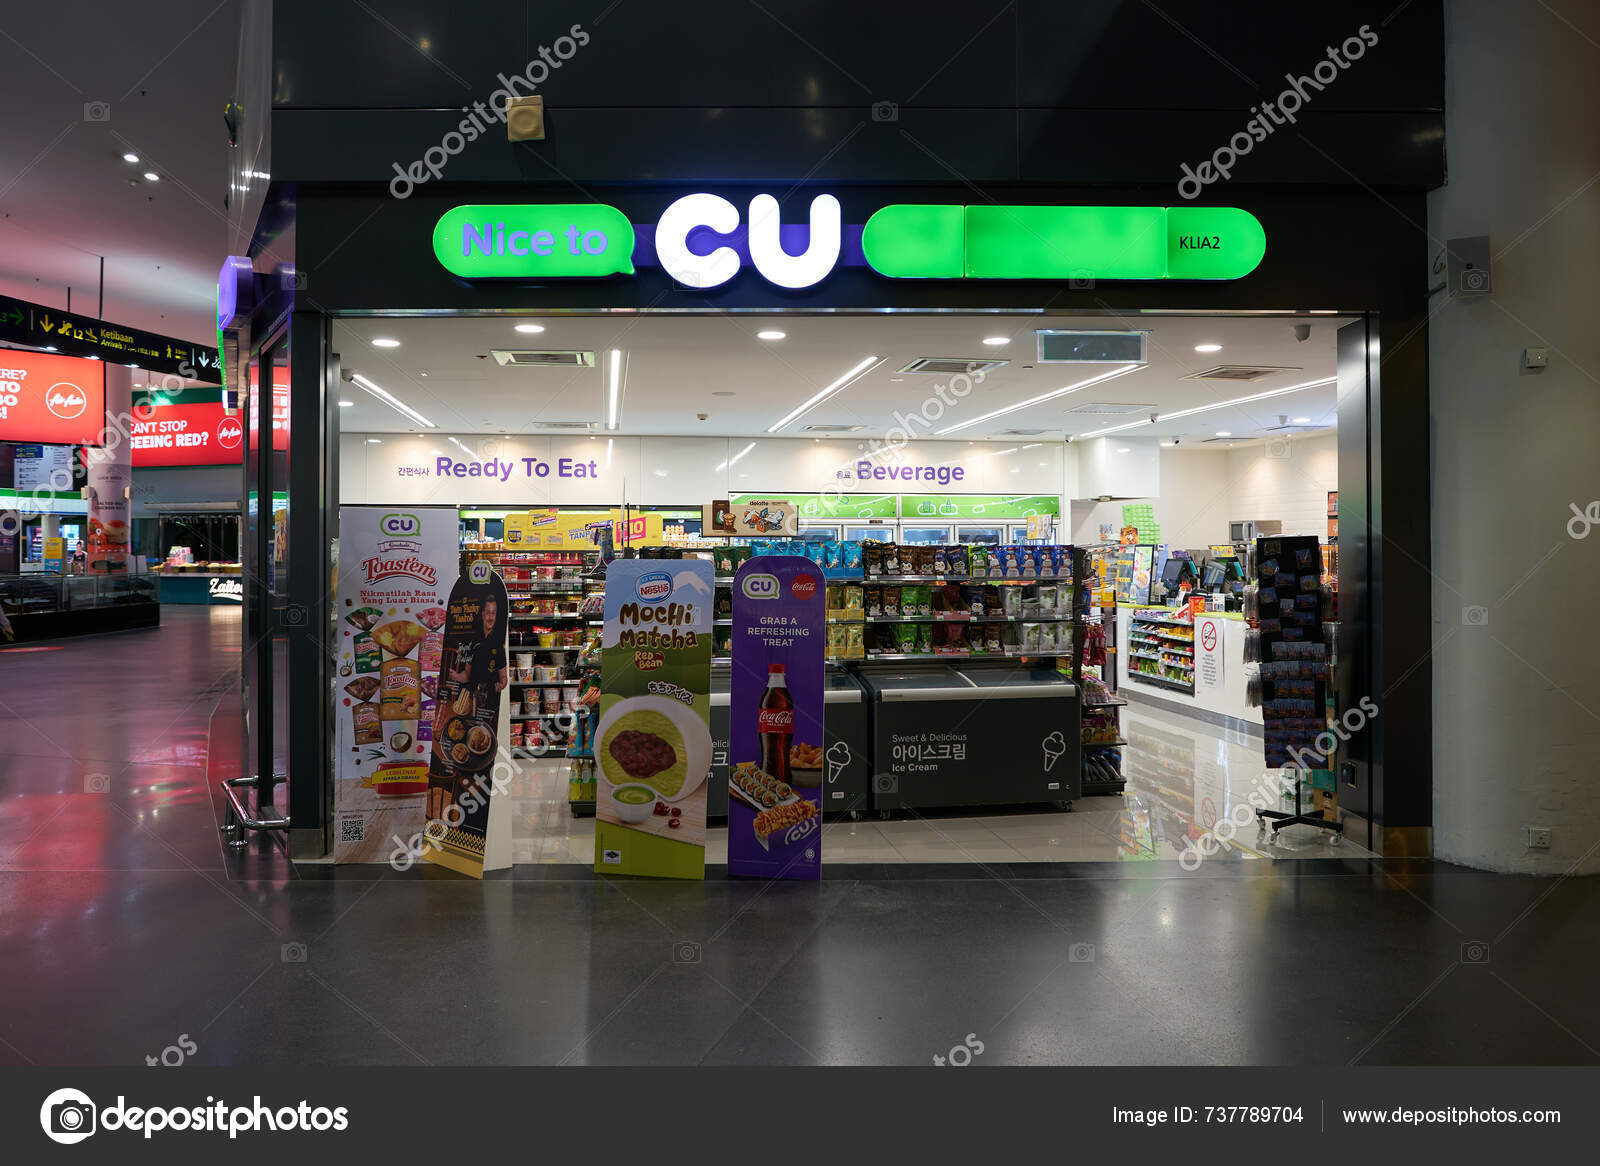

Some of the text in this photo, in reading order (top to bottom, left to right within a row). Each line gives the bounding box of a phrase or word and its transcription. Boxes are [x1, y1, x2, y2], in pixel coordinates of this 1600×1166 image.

[462, 223, 608, 256] Nice to
[655, 193, 842, 289] CU
[1180, 236, 1220, 249] KLIA2
[101, 328, 134, 344] Ketibaan
[160, 420, 188, 432] STOP
[176, 432, 209, 447] RED?
[398, 467, 429, 477] 간편식사
[436, 457, 597, 482] Ready To Eat
[857, 461, 965, 485] Beverage
[388, 520, 413, 531] CU
[474, 567, 487, 577] CU
[750, 581, 772, 592] CU
[760, 617, 798, 625] GRAB A
[619, 626, 699, 649] Matcha
[748, 628, 810, 636] REFRESHING
[763, 639, 794, 647] TREAT
[892, 734, 919, 742] Sweet
[929, 733, 967, 742] Delicious
[892, 744, 966, 762] 아이스크림
[892, 763, 938, 772] Ice Cream
